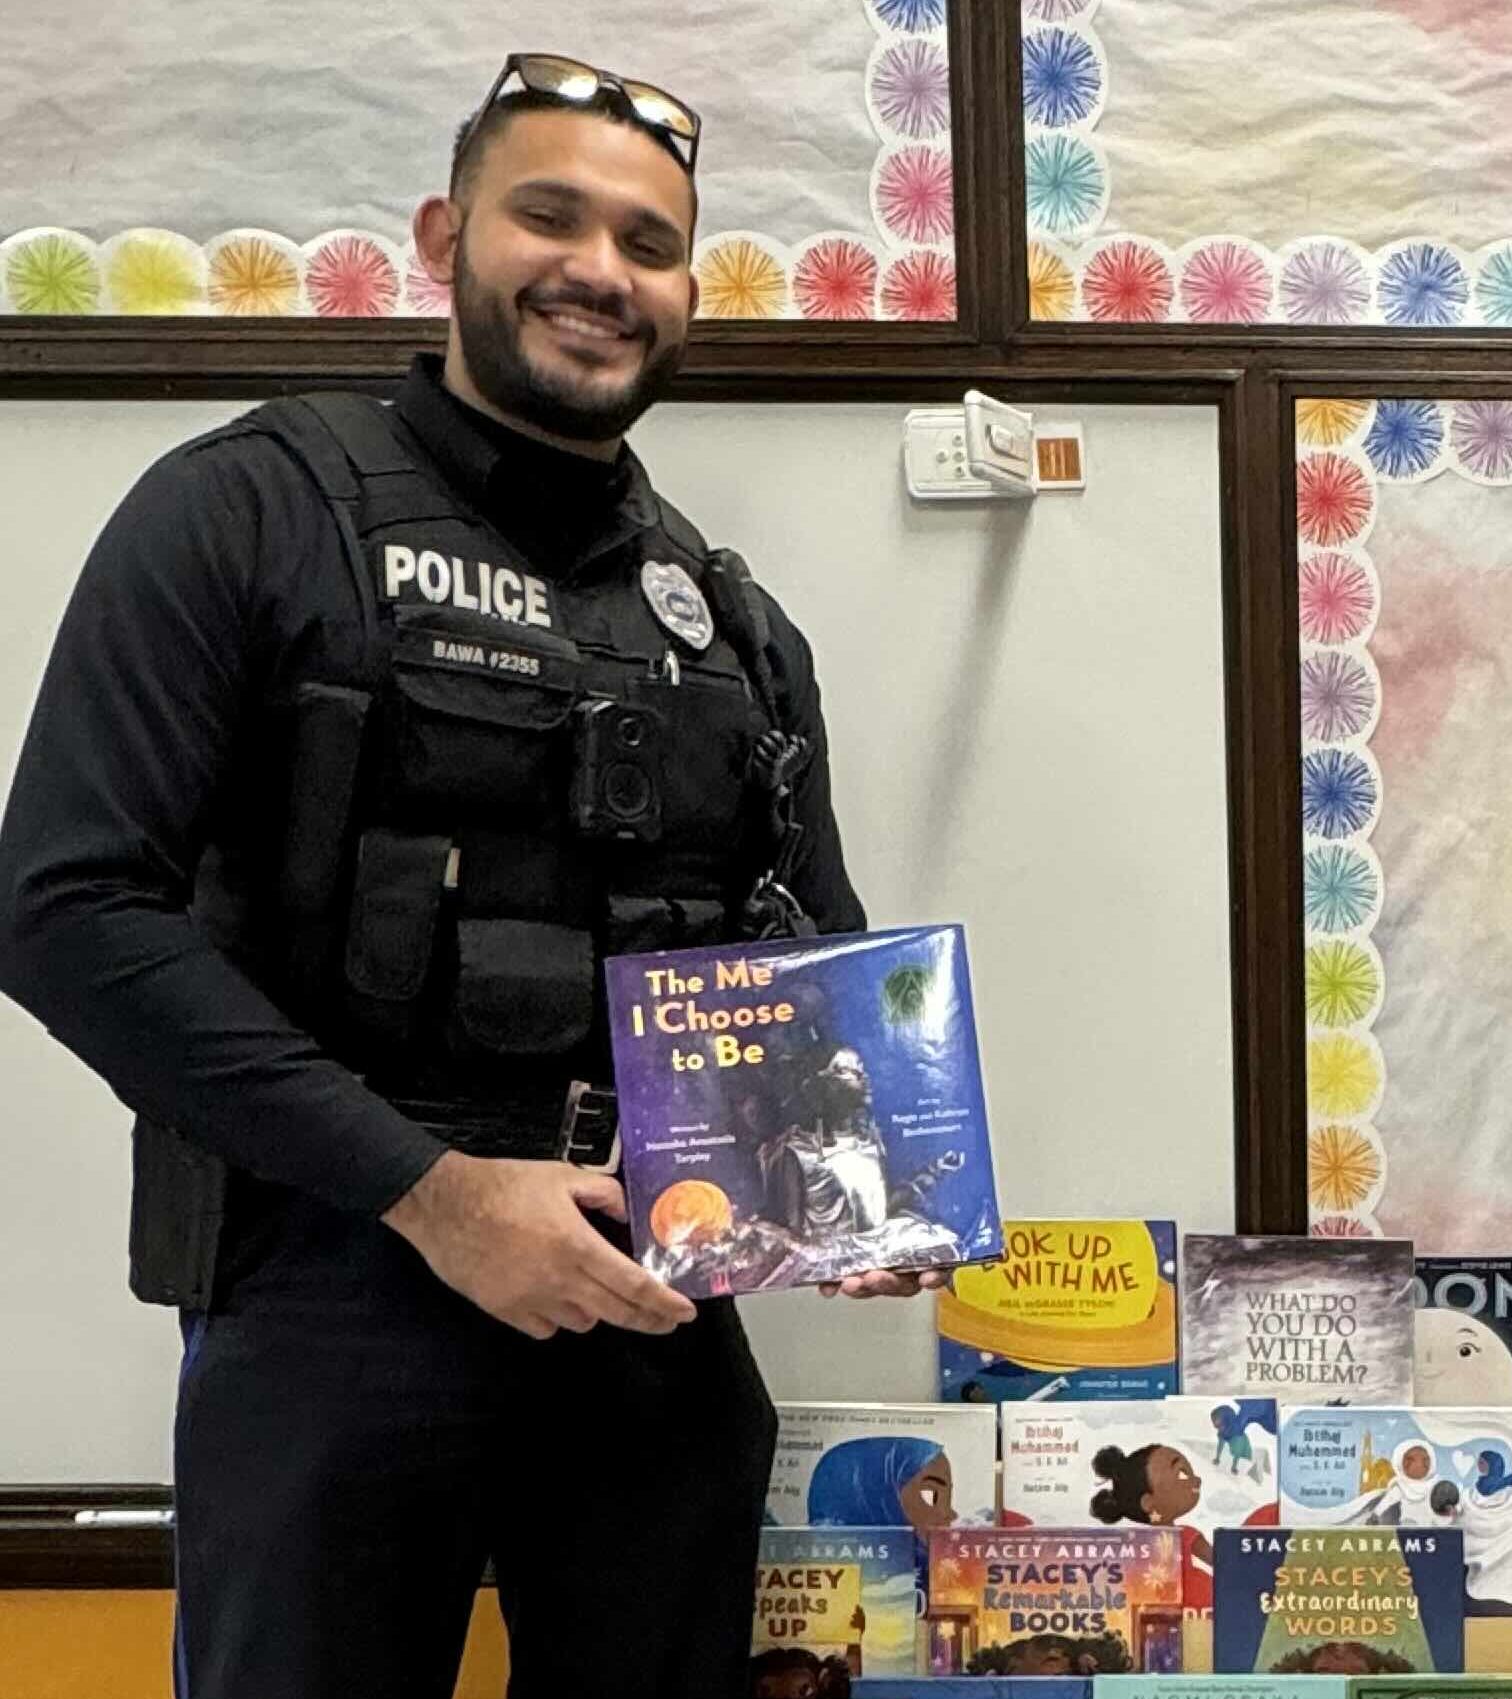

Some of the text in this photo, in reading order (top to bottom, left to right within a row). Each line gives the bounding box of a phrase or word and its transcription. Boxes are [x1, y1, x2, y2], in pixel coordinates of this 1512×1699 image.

[384, 545, 552, 628] POLICE
[433, 640, 485, 666] BAWA
[645, 959, 773, 997] The Me
[632, 1000, 796, 1036] I Choose
[672, 1035, 765, 1072] to Be
[1069, 1233, 1112, 1263] UP
[1003, 1260, 1139, 1293] WITH ME
[1246, 1292, 1357, 1313] WHAT DO
[1246, 1313, 1357, 1338] YOU DO
[1246, 1336, 1355, 1363] WITH A
[1246, 1361, 1368, 1384] PROBLEM?
[959, 1543, 1151, 1559] STACEY ABRAMS
[1241, 1537, 1437, 1553] STACEY ABRAMS
[987, 1561, 1124, 1585] STACEY'S
[1274, 1565, 1413, 1587] STACEY'S
[760, 1593, 828, 1619] peaks
[983, 1586, 1127, 1611] Remarkable
[1259, 1591, 1420, 1620] Extraordinary
[769, 1618, 806, 1637] UP
[1009, 1612, 1107, 1634] BOOKS
[1285, 1616, 1398, 1637] WORDS
